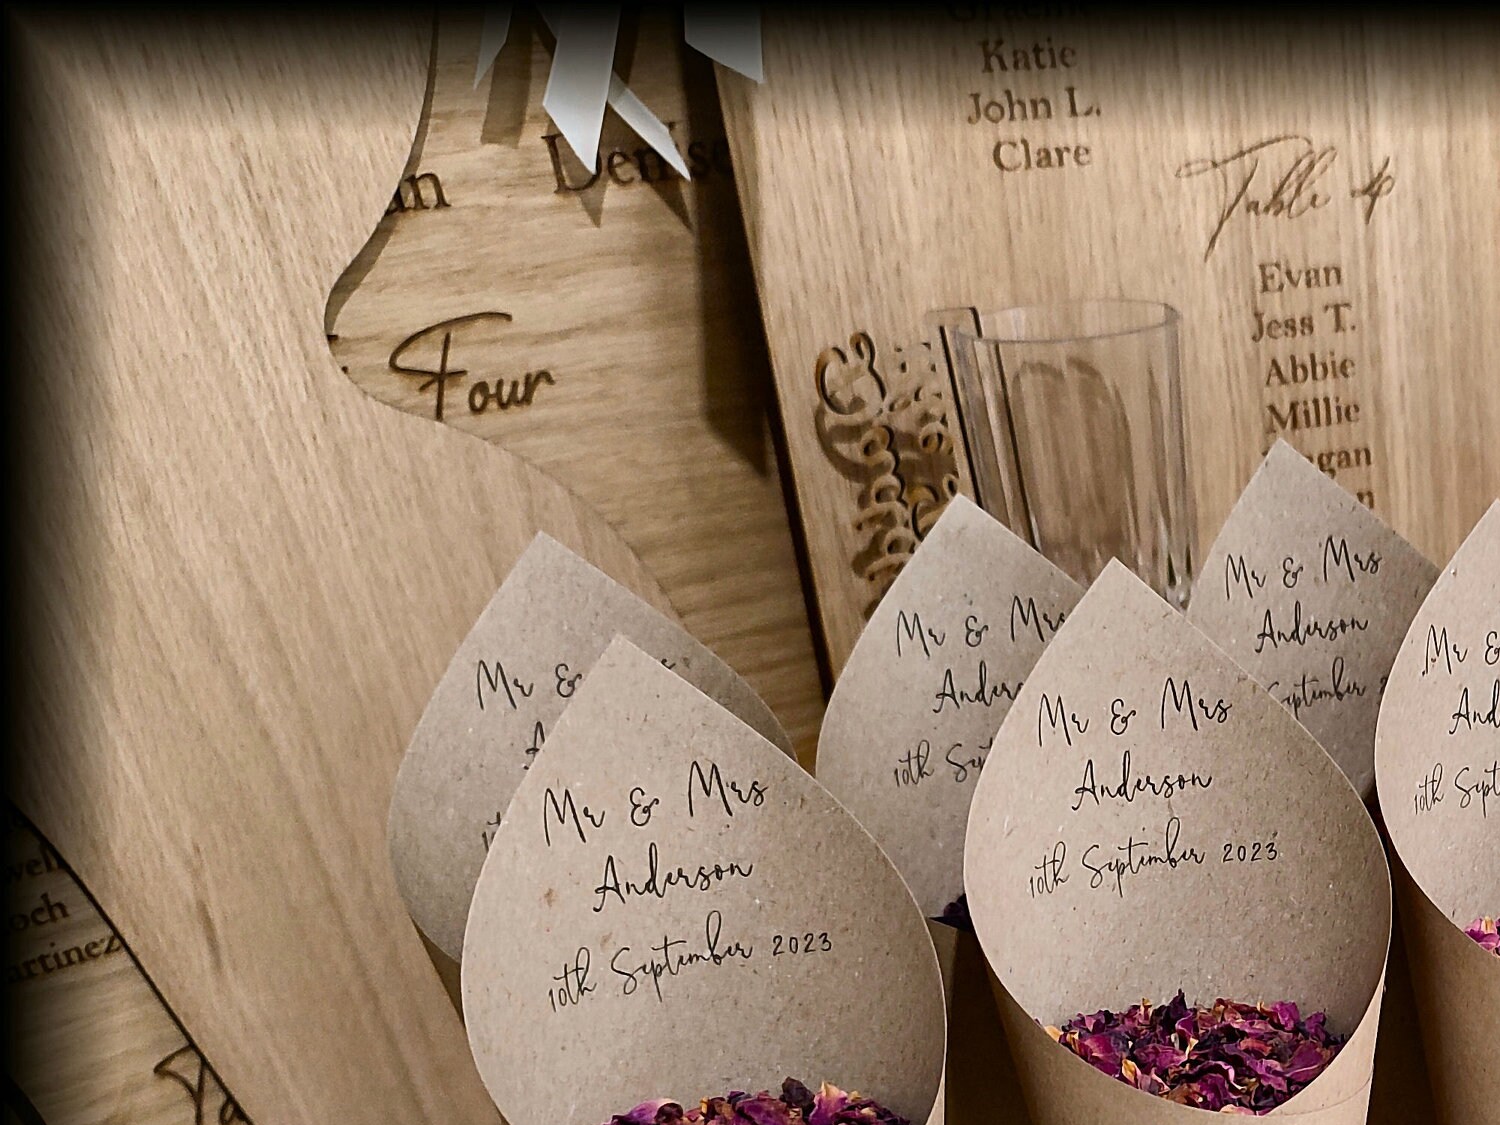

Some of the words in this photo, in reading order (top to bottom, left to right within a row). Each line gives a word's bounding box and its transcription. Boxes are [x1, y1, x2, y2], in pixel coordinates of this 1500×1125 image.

[979, 36, 1077, 73] Katie
[967, 88, 1053, 125] John
[1064, 86, 1102, 118] L.
[993, 136, 1093, 172] Clare
[1175, 134, 1337, 264] Table
[1350, 156, 1396, 225] 4
[1258, 262, 1342, 294] Evan
[1252, 311, 1314, 343] Jess
[1324, 302, 1356, 334] T.
[389, 311, 556, 422] Four
[1265, 351, 1356, 386] Abbie
[1265, 396, 1361, 433] Millie
[1224, 553, 1267, 601] Mr
[1282, 556, 1304, 589] &
[1323, 535, 1384, 582] Mrs
[896, 610, 946, 657] Mr
[965, 615, 989, 648] &
[1255, 601, 1370, 653] Anderson
[1422, 625, 1469, 676] Mr
[477, 659, 535, 710] Mr
[555, 663, 583, 698] &
[932, 660, 1025, 714] Ander
[1267, 656, 1368, 722] eptember
[1038, 693, 1090, 747] Mr
[1110, 698, 1137, 735] &
[1161, 677, 1234, 731] Mrs
[894, 739, 935, 788] 10th
[1071, 750, 1214, 811] Anderson
[1413, 763, 1445, 814] 10th
[543, 787, 606, 847] Mr
[629, 786, 660, 827] &
[687, 760, 769, 817] Mrs
[592, 842, 754, 912] Anderson
[1029, 841, 1070, 899] 10th
[1081, 817, 1207, 899] September
[1222, 842, 1280, 864] 2023
[547, 946, 598, 1013] 10th
[610, 910, 753, 1003] September
[772, 932, 833, 957] 2023
